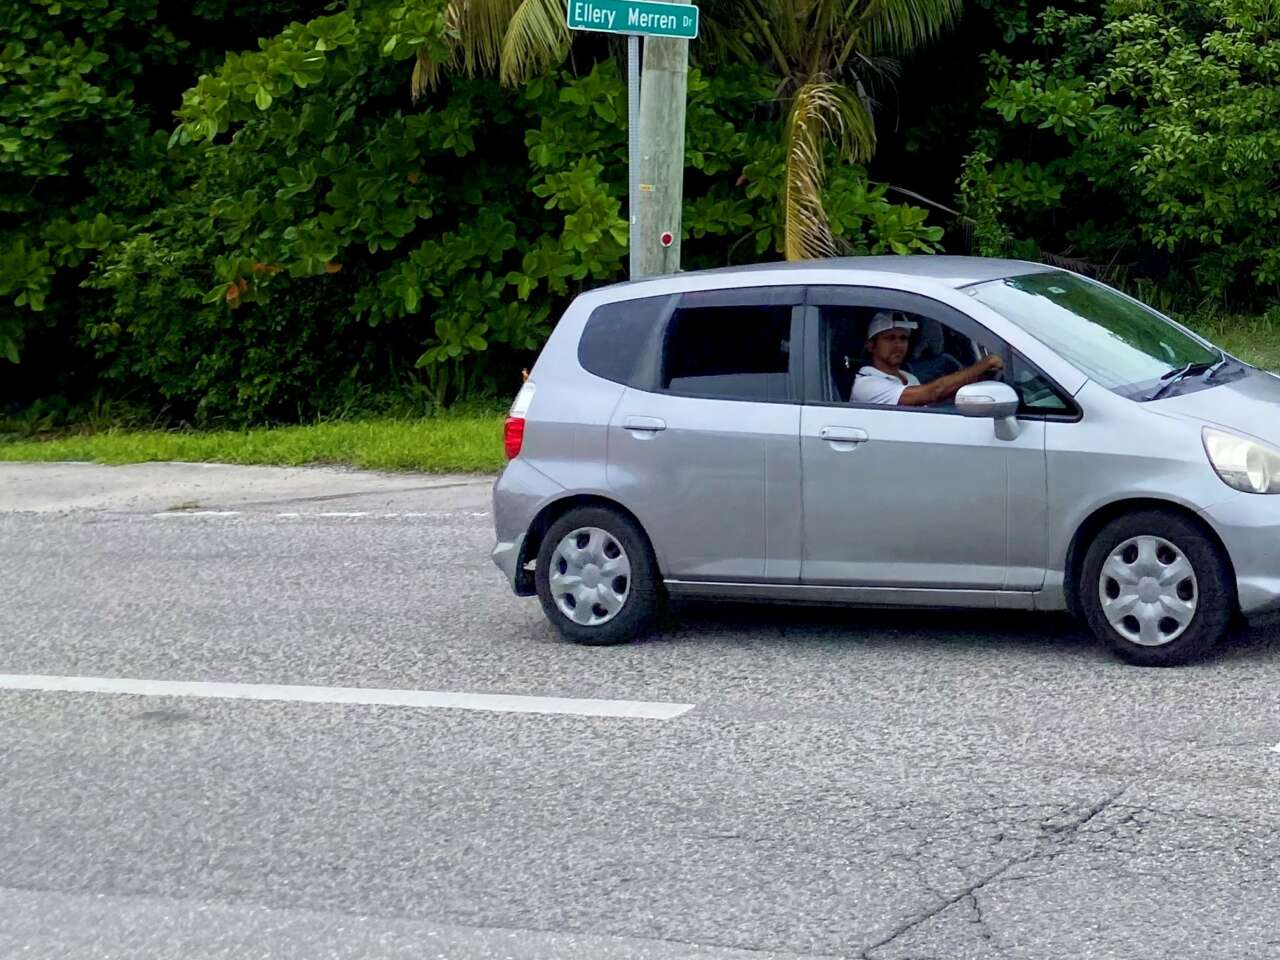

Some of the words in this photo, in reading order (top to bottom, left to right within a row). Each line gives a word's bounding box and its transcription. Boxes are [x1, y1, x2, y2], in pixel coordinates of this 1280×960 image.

[575, 2, 616, 28] Ellery
[628, 7, 677, 29] Merren
[682, 15, 692, 27] Dr
